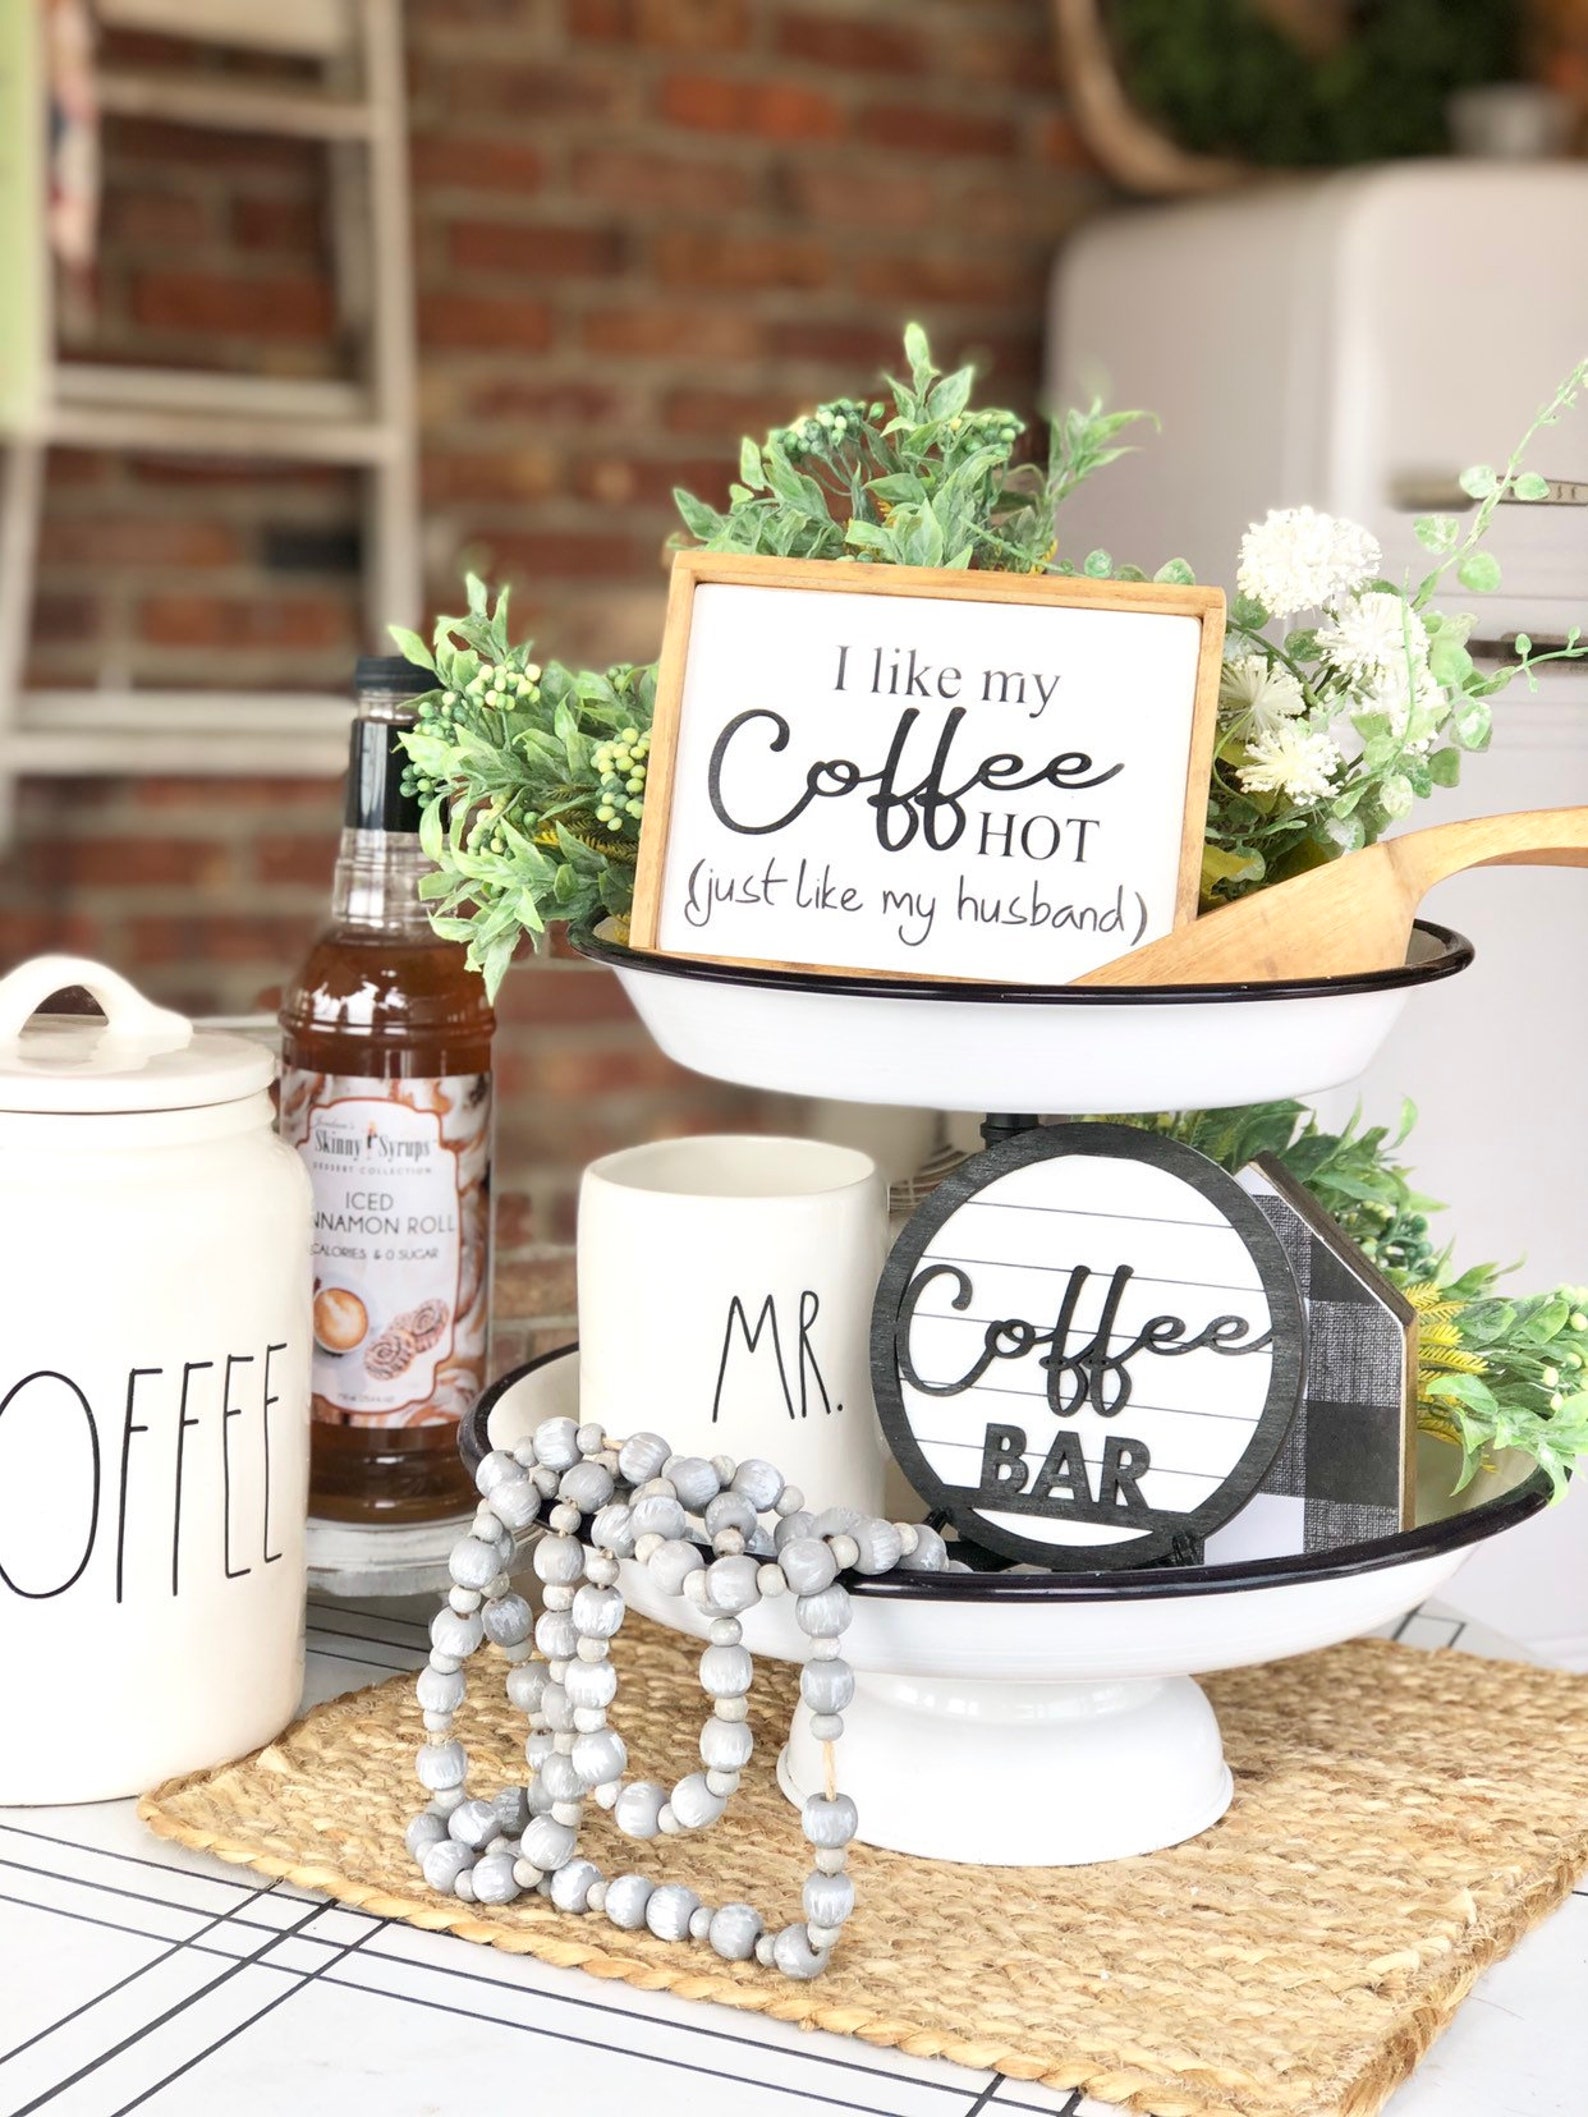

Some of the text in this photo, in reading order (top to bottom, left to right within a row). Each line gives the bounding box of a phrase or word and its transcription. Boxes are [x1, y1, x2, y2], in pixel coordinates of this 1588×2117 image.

[833, 645, 1062, 718] I like my
[708, 706, 1126, 852] Coffee
[976, 811, 1101, 863] HOT
[684, 857, 1149, 946] (just like my husband)
[313, 1162, 432, 1175] DESSERT COLLECTION
[315, 1129, 431, 1163] Skinny Syrups
[313, 1211, 456, 1235] NNAMON ROLL
[345, 1191, 394, 1211] ICED
[310, 1242, 367, 1260] CALORIES
[399, 1248, 439, 1260] SUGAR
[711, 1290, 844, 1423] MR.
[899, 1264, 1273, 1418] Coffee
[0, 1341, 288, 1603] OFFEE
[979, 1422, 1151, 1510] BAR
